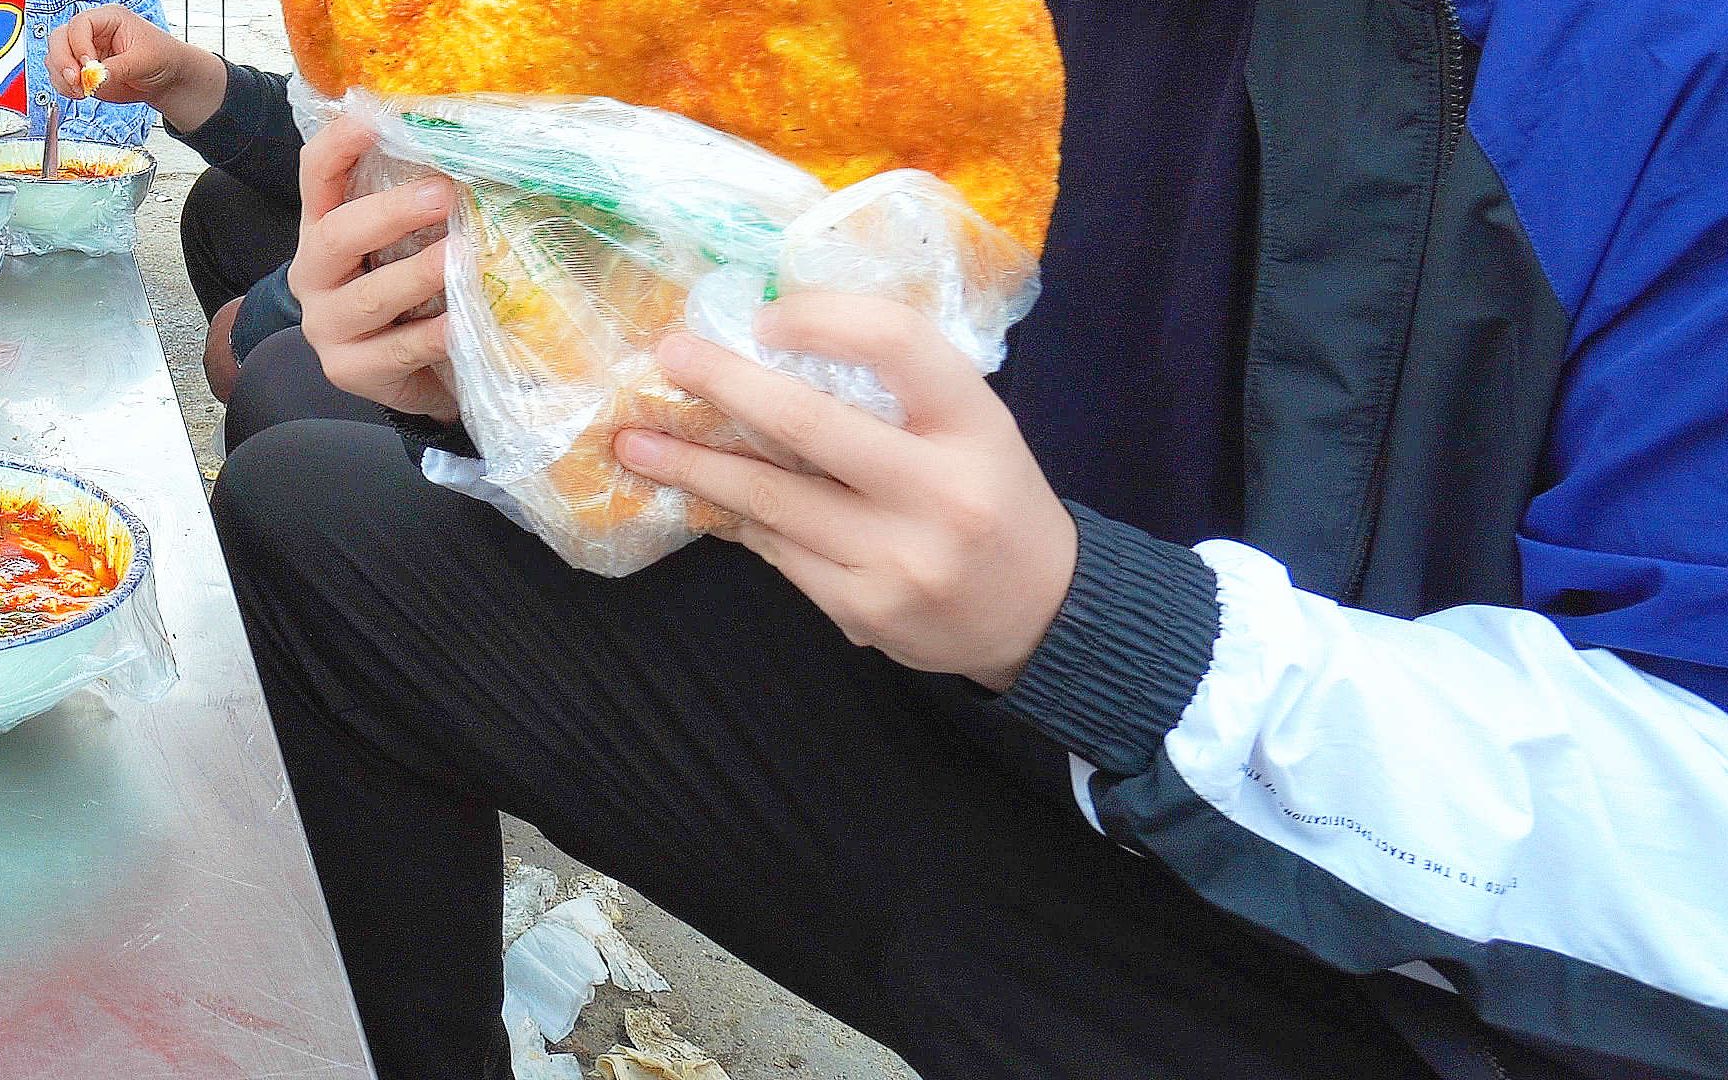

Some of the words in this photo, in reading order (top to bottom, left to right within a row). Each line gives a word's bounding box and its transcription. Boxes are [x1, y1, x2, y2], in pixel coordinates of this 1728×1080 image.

[1374, 837, 1416, 866] EXACT
[1423, 858, 1452, 879] THE
[1459, 872, 1477, 887] TO
